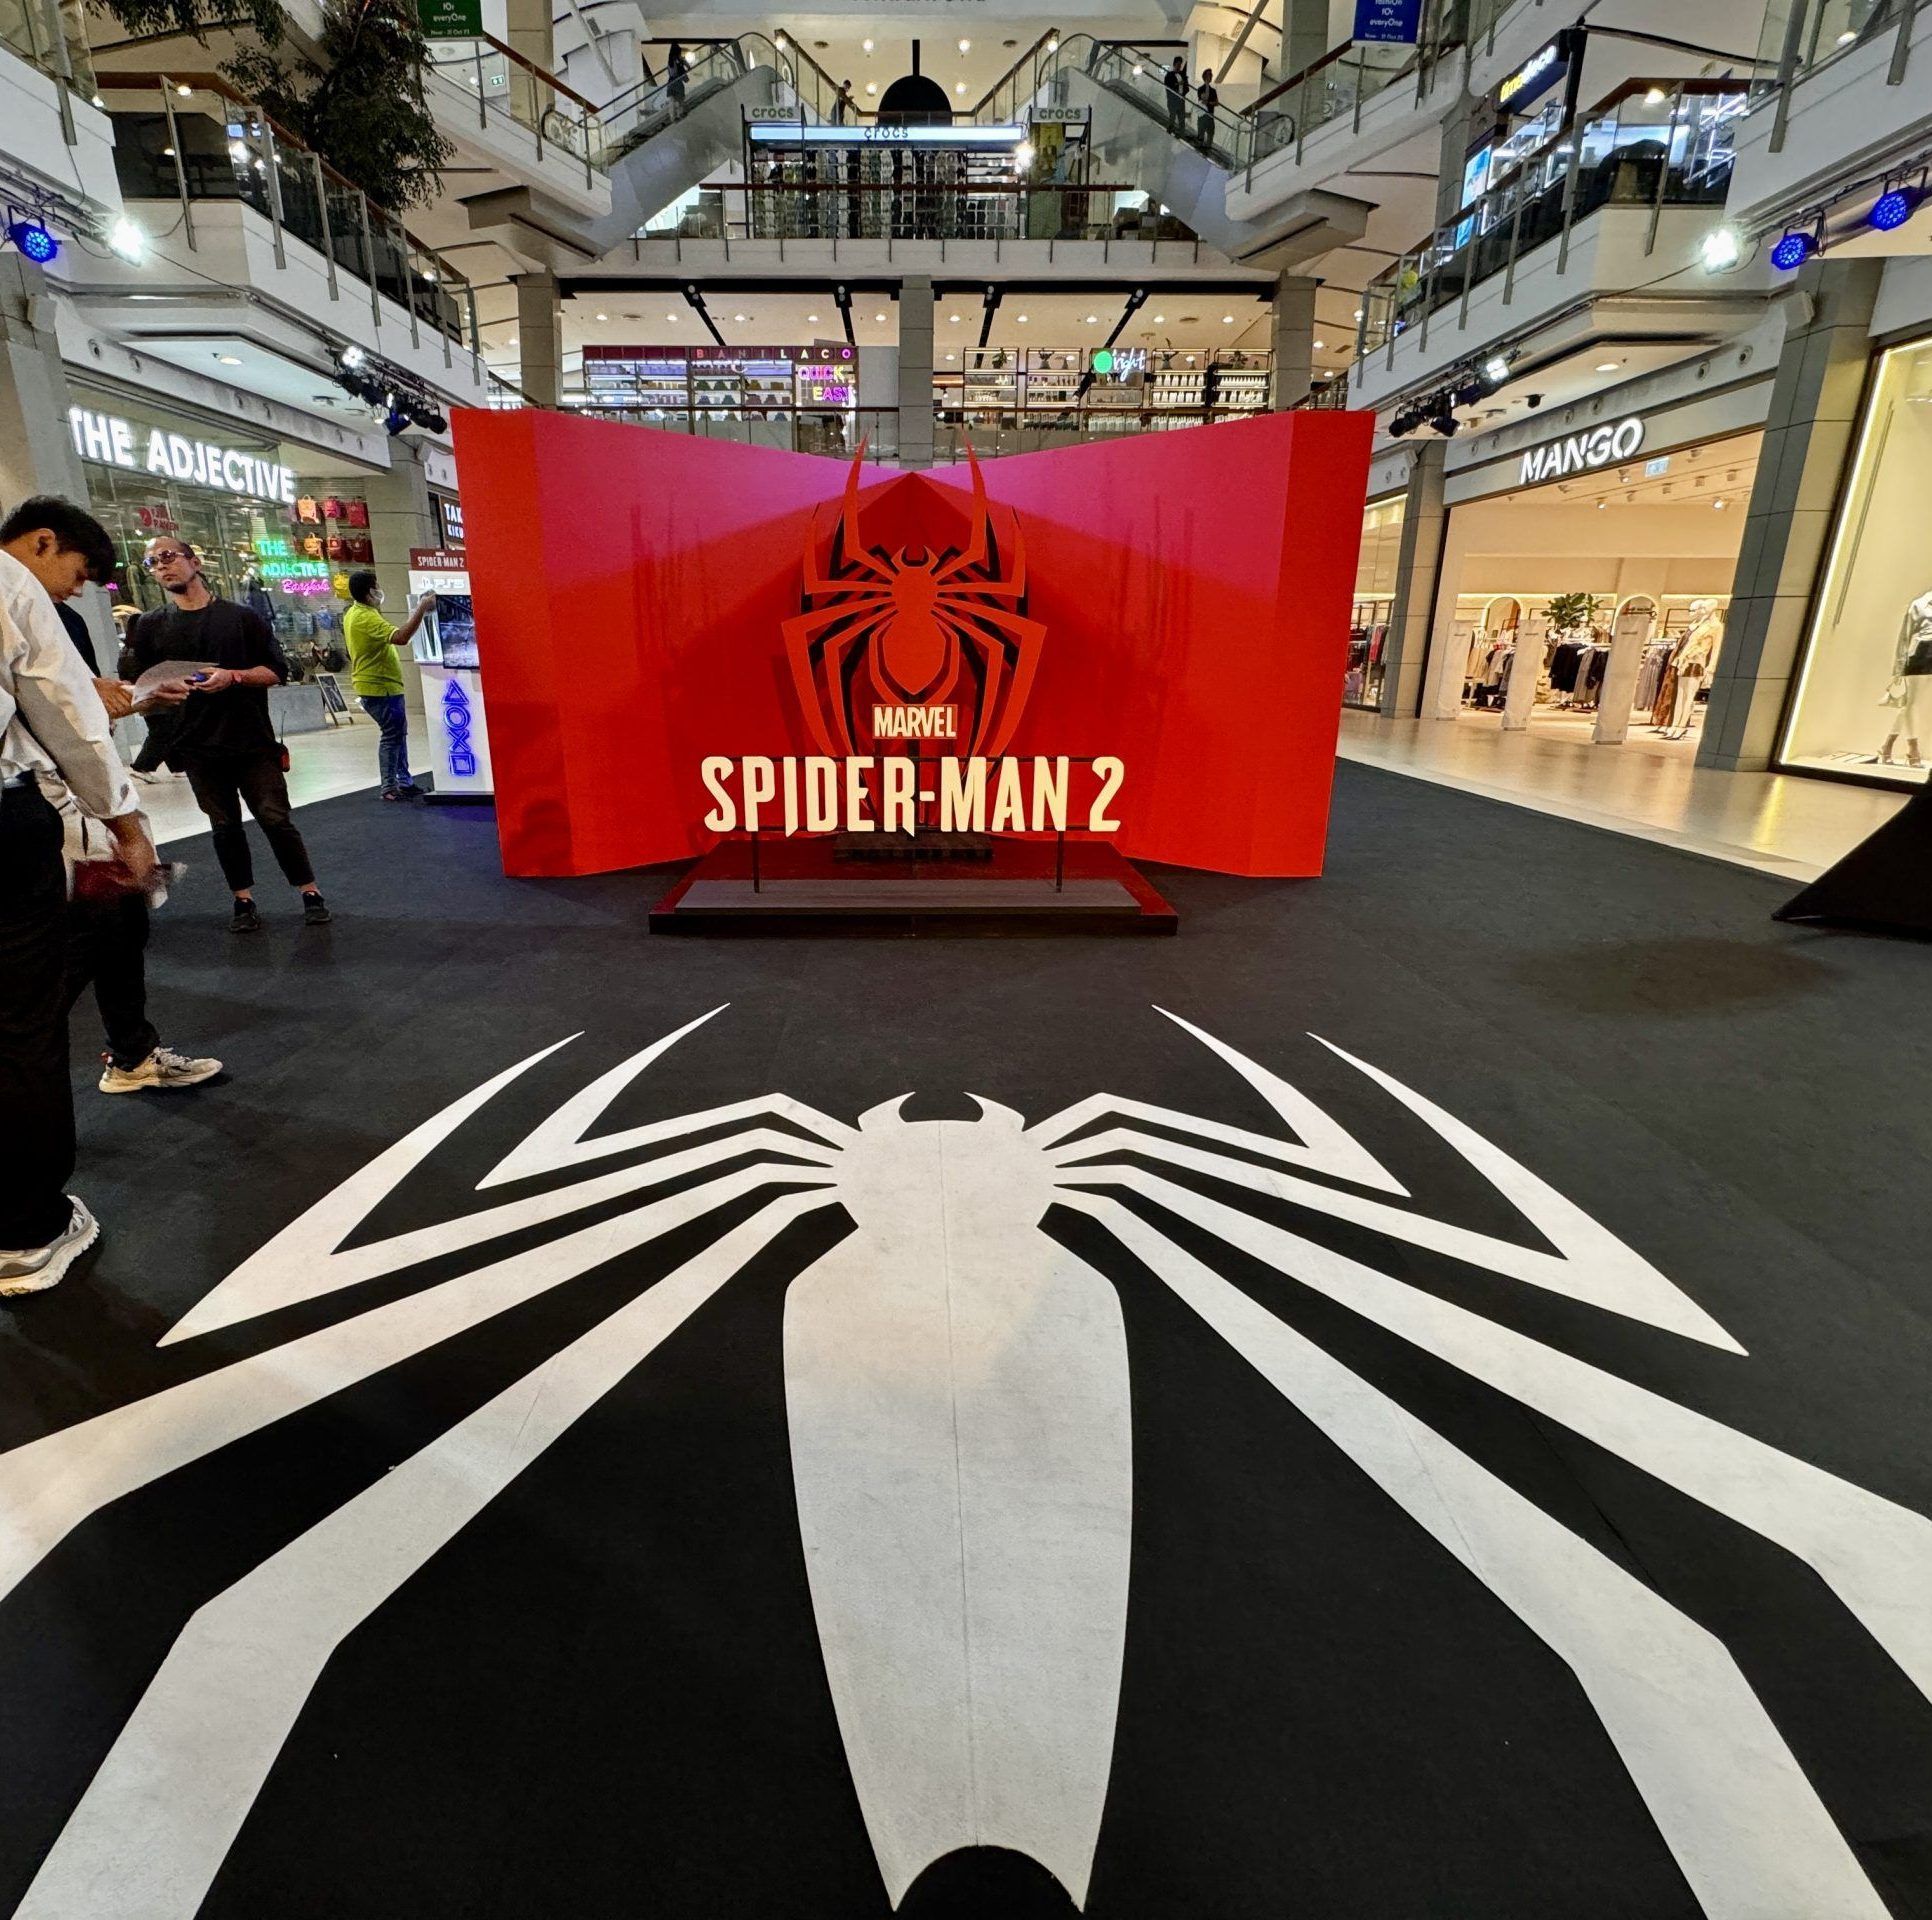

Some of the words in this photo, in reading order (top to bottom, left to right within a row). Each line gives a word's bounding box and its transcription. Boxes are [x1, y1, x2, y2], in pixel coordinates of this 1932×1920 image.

[432, 13, 466, 23] everyOne
[1369, 18, 1403, 28] everyOne
[752, 106, 794, 119] crocs
[1039, 108, 1081, 120] crocs
[864, 126, 909, 140] crocs
[799, 364, 844, 382] QUICK
[68, 406, 137, 468] THE
[145, 428, 297, 505] ADJECTIVE
[1519, 417, 1645, 486] MANGO
[256, 539, 289, 556] THE
[417, 556, 458, 568] SPIDER-MAN
[459, 557, 464, 568] 2
[874, 706, 957, 738] MARVEL
[701, 756, 1069, 837] SPIDER-MAN
[1089, 756, 1125, 832] 2
